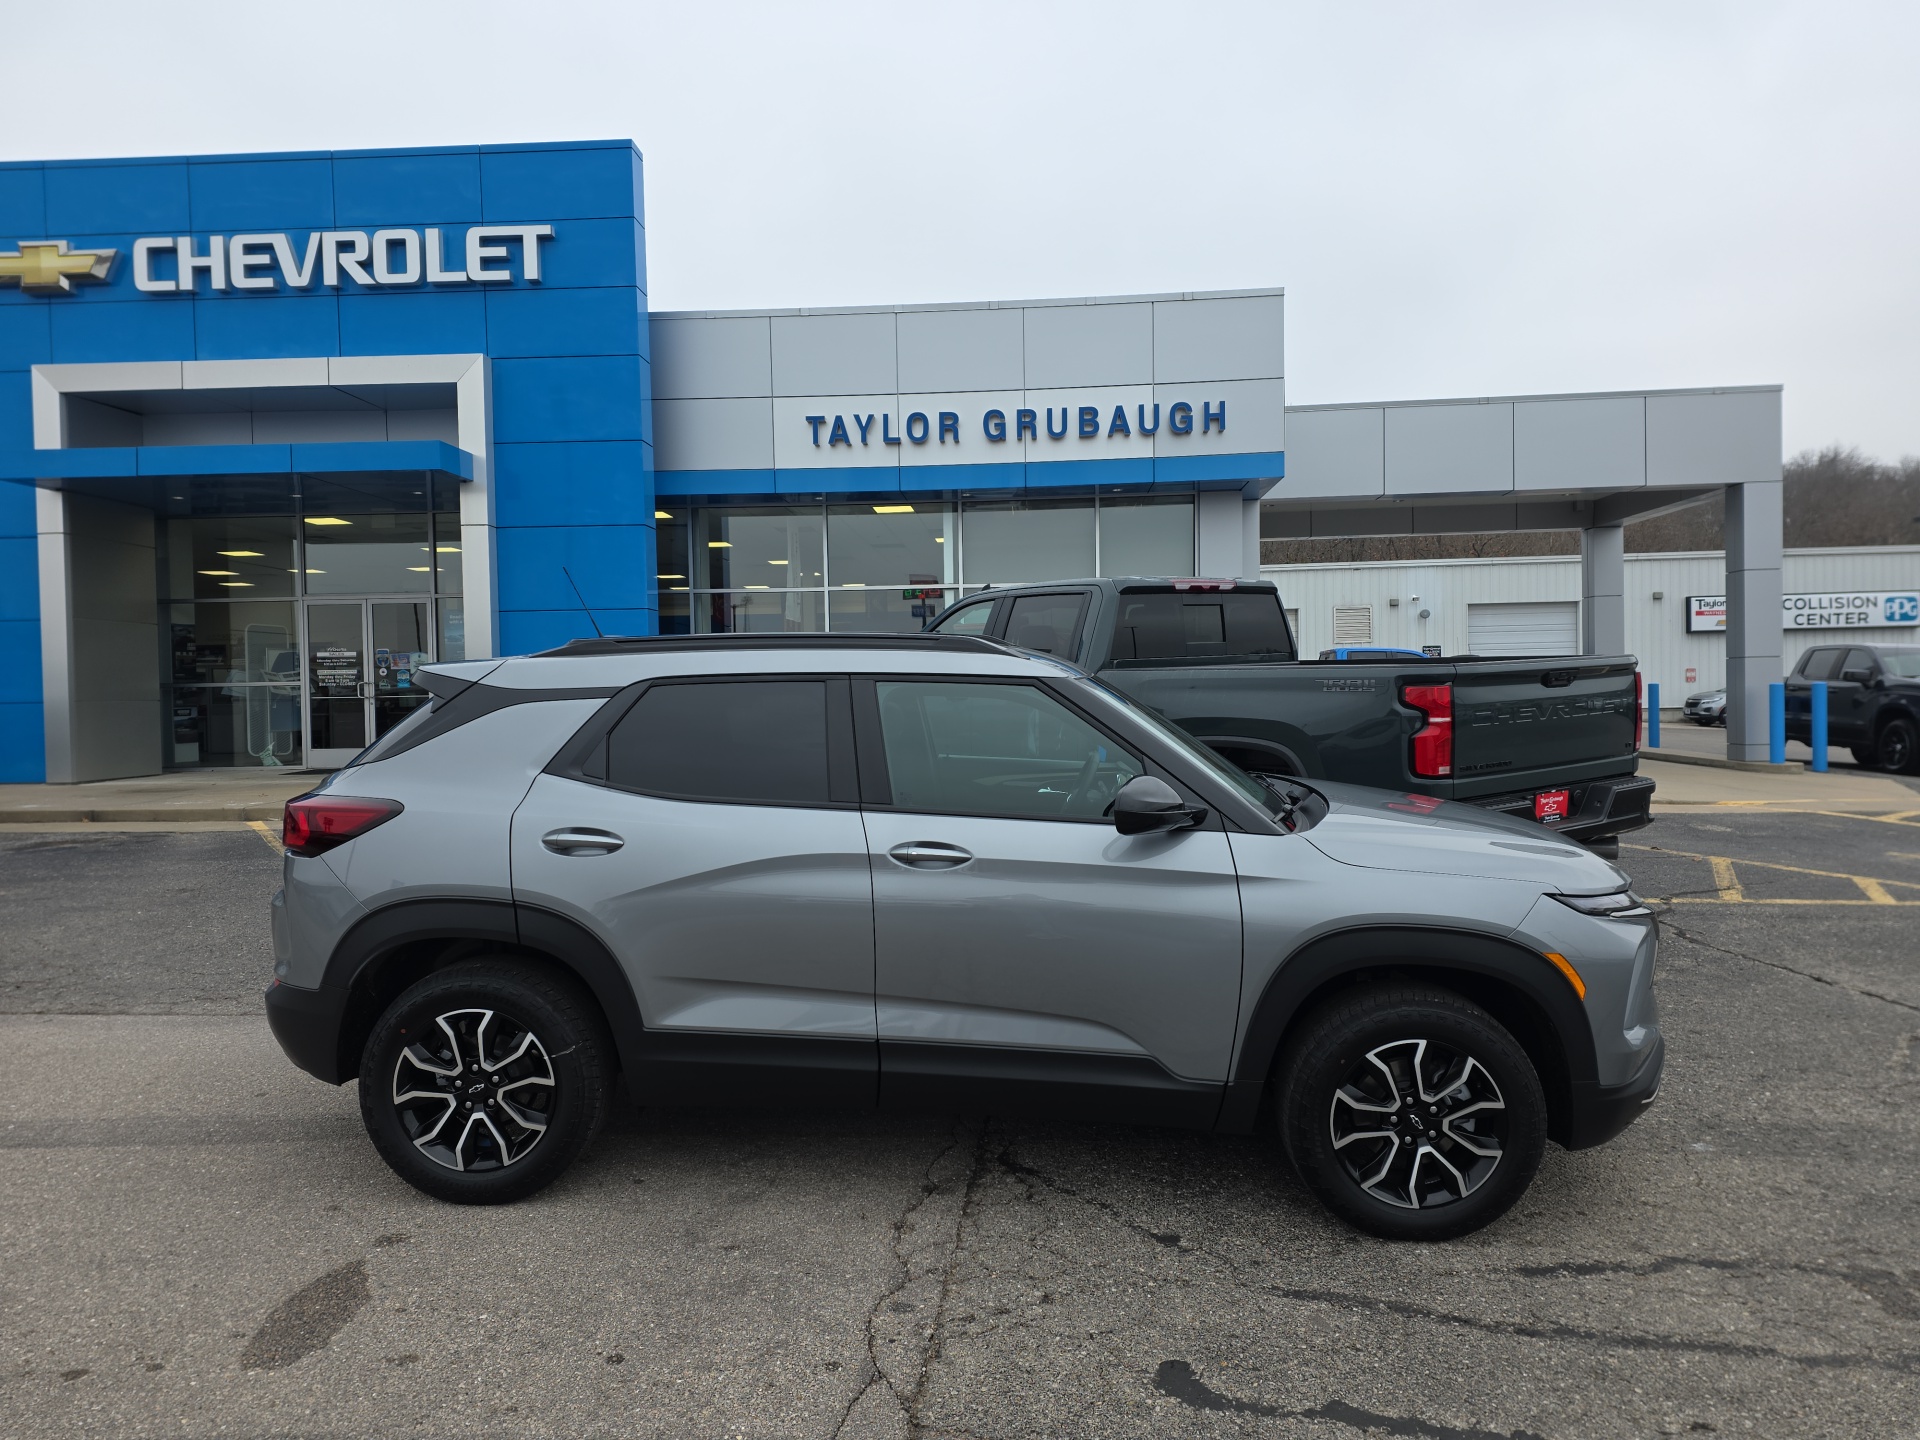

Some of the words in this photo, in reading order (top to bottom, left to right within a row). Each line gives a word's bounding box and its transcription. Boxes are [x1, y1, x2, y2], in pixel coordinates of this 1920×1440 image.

[133, 225, 556, 293] CHEVROLET
[806, 410, 961, 447] TAYLOR
[982, 400, 1226, 443] GRUBAUGH
[1696, 599, 1727, 609] Taylor
[1783, 596, 1878, 610] COLLISION
[1886, 598, 1918, 620] PPG
[1794, 612, 1869, 625] CENTER
[1315, 679, 1385, 687] TRAIL
[1471, 698, 1628, 727] CHEVROLET
